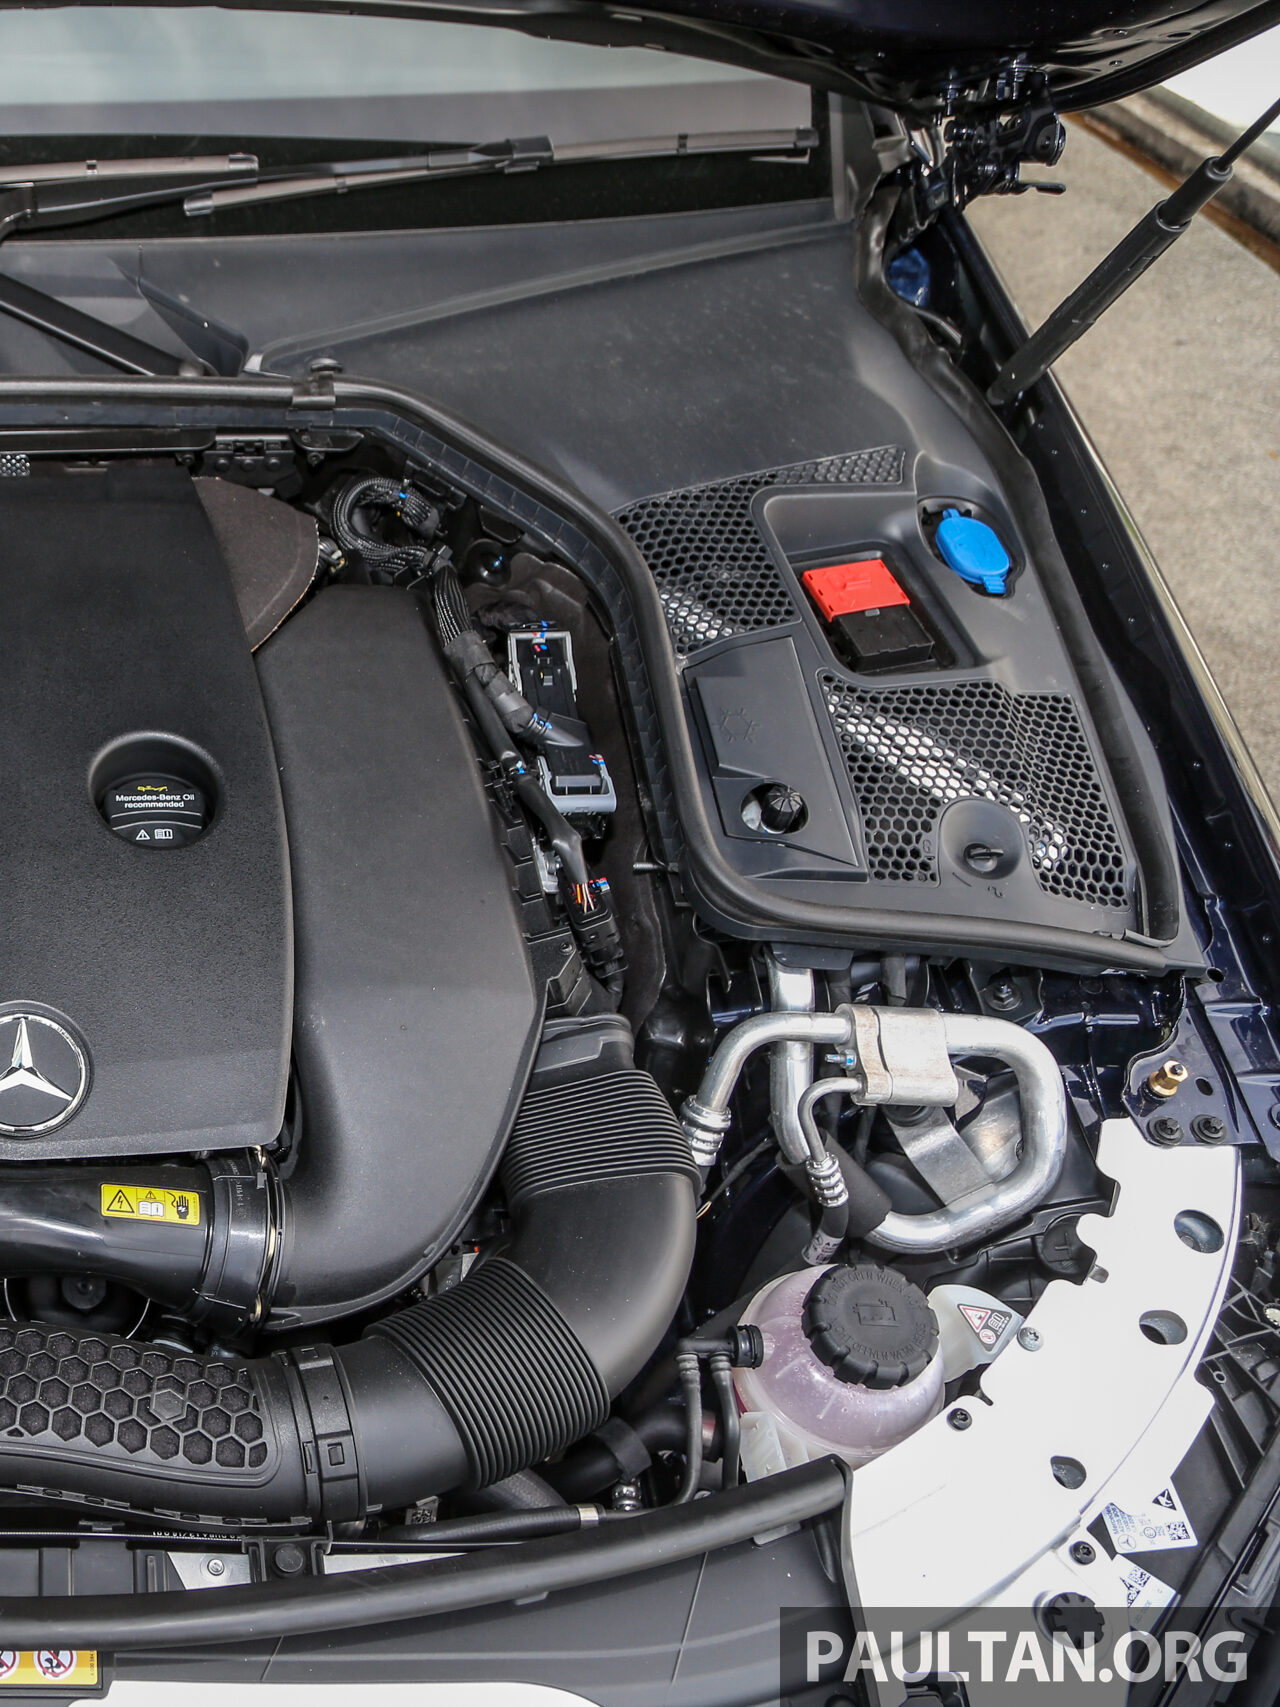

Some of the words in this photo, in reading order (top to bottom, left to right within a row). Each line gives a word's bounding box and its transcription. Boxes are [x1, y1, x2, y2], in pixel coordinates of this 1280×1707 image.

[115, 793, 181, 802] Mercedes-Benz
[182, 793, 195, 801] Oil
[124, 800, 185, 808] recommended
